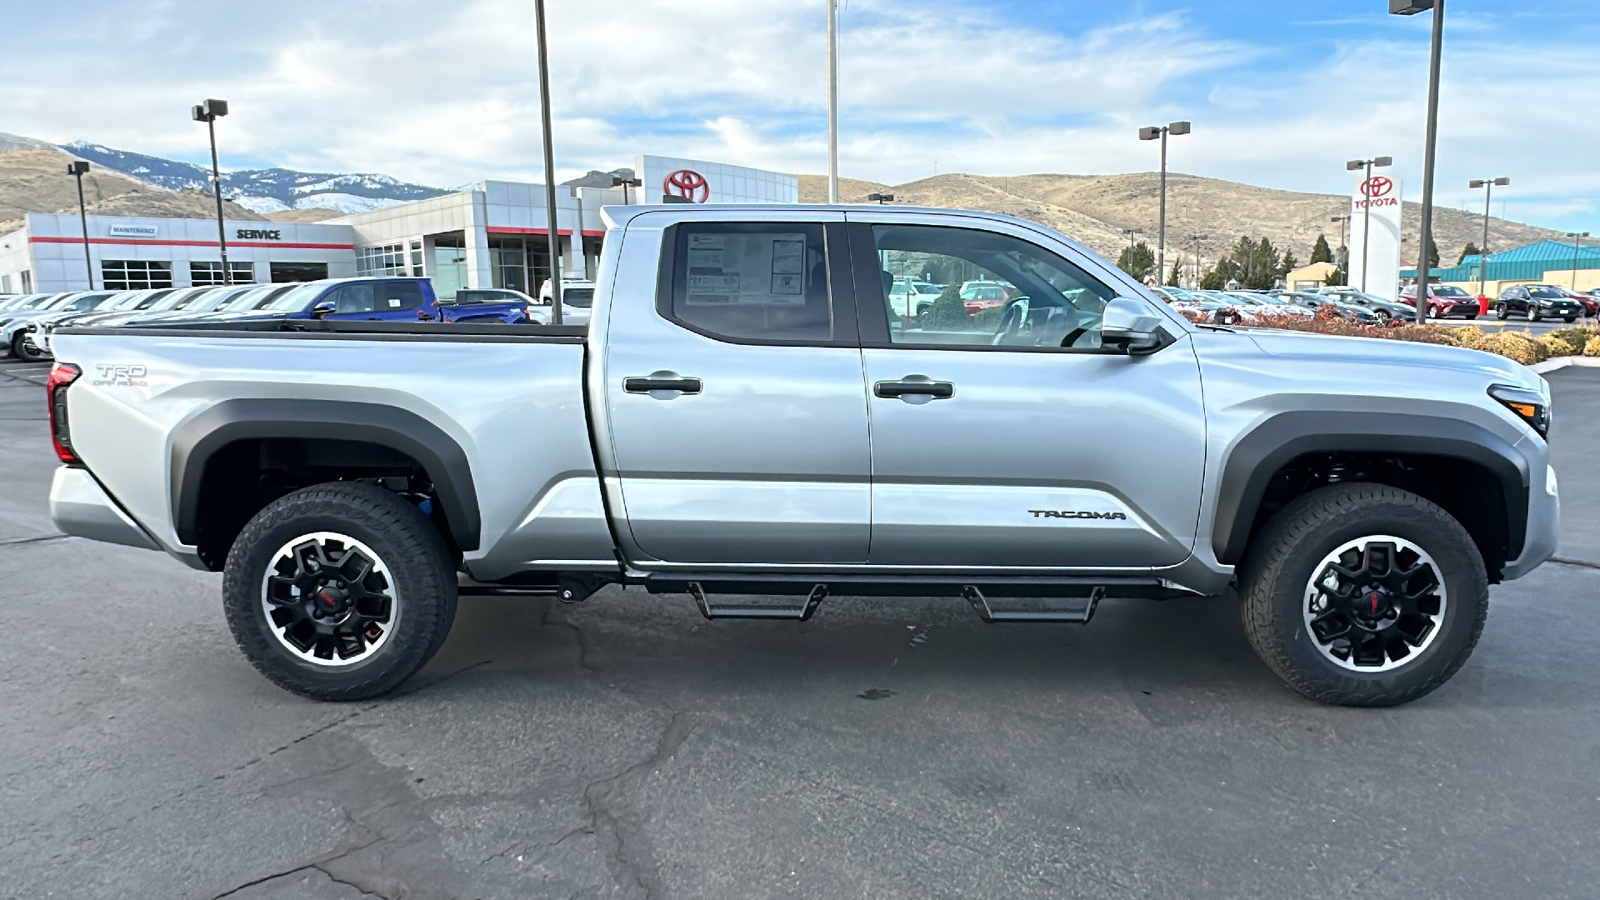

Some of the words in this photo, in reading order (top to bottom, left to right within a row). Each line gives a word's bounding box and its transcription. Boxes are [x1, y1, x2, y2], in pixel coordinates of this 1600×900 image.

[1355, 197, 1398, 208] TOYOTA
[113, 227, 155, 235] MAINTENANCE
[237, 229, 281, 240] SERVICE
[97, 364, 148, 381] TRD
[1028, 510, 1127, 520] TACOMA
